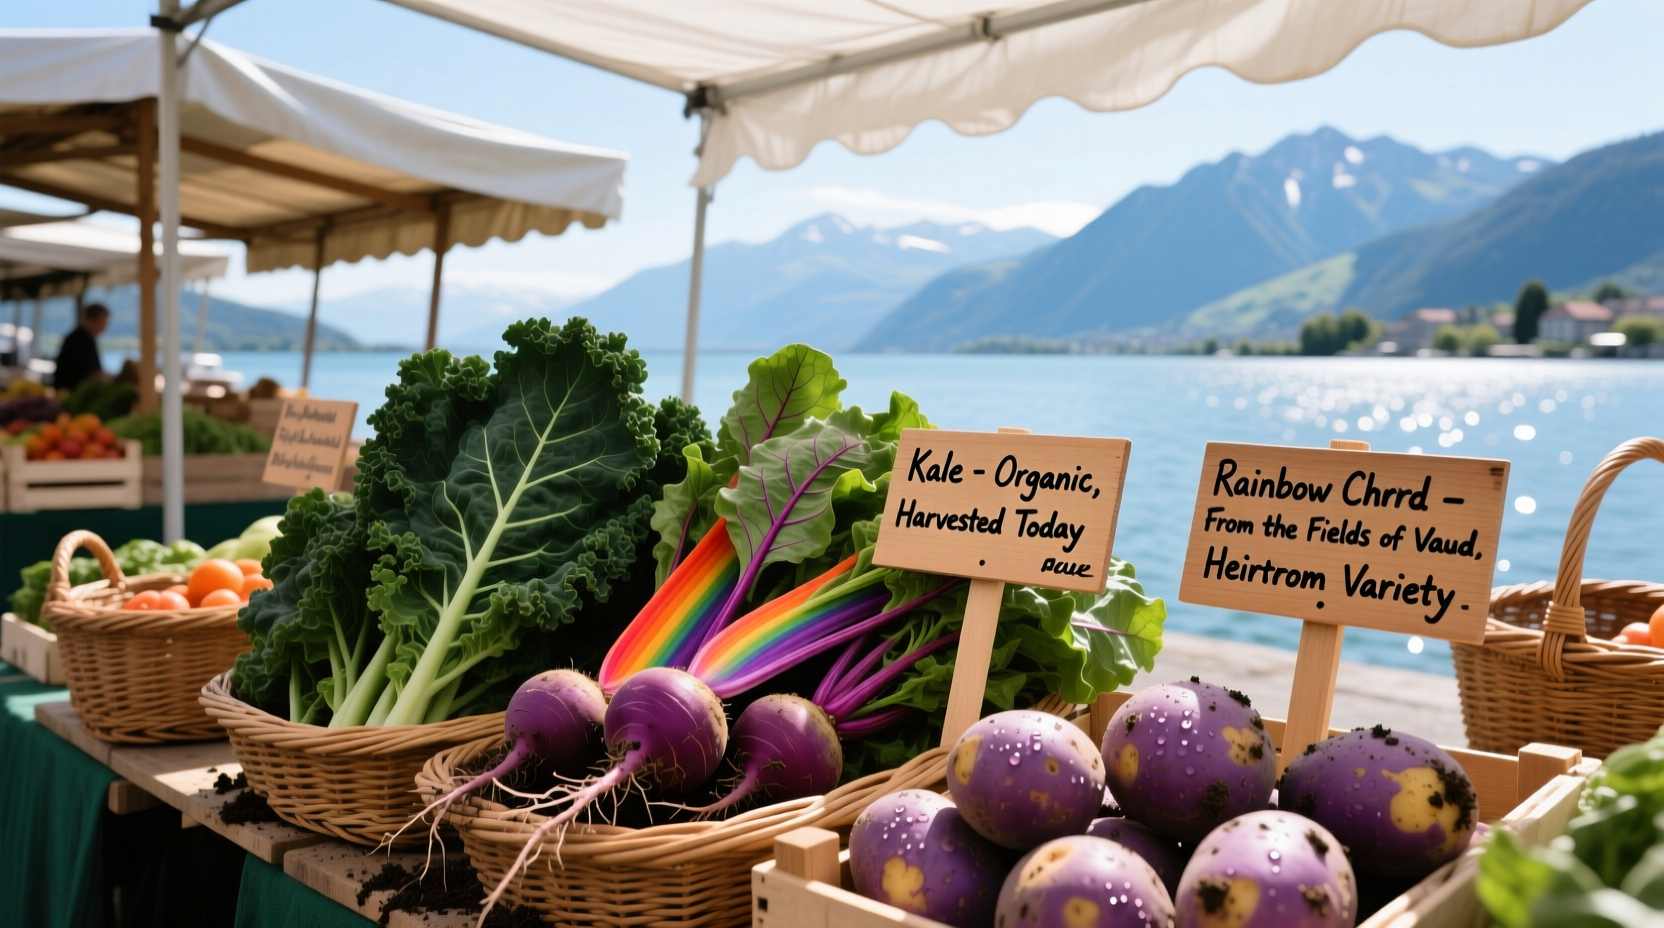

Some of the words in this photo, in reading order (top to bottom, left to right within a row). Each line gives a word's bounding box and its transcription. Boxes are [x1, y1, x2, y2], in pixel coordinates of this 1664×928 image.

[907, 447, 964, 483] Kale
[994, 454, 1101, 502] Organic,
[1213, 458, 1333, 503] Rainbow
[895, 498, 1007, 535] Harvested
[1015, 508, 1085, 553] Today
[1204, 506, 1254, 535] From
[1262, 513, 1298, 540] the
[1306, 516, 1371, 547] Fields
[1379, 524, 1407, 551] of
[1203, 545, 1326, 590] Heirtrom
